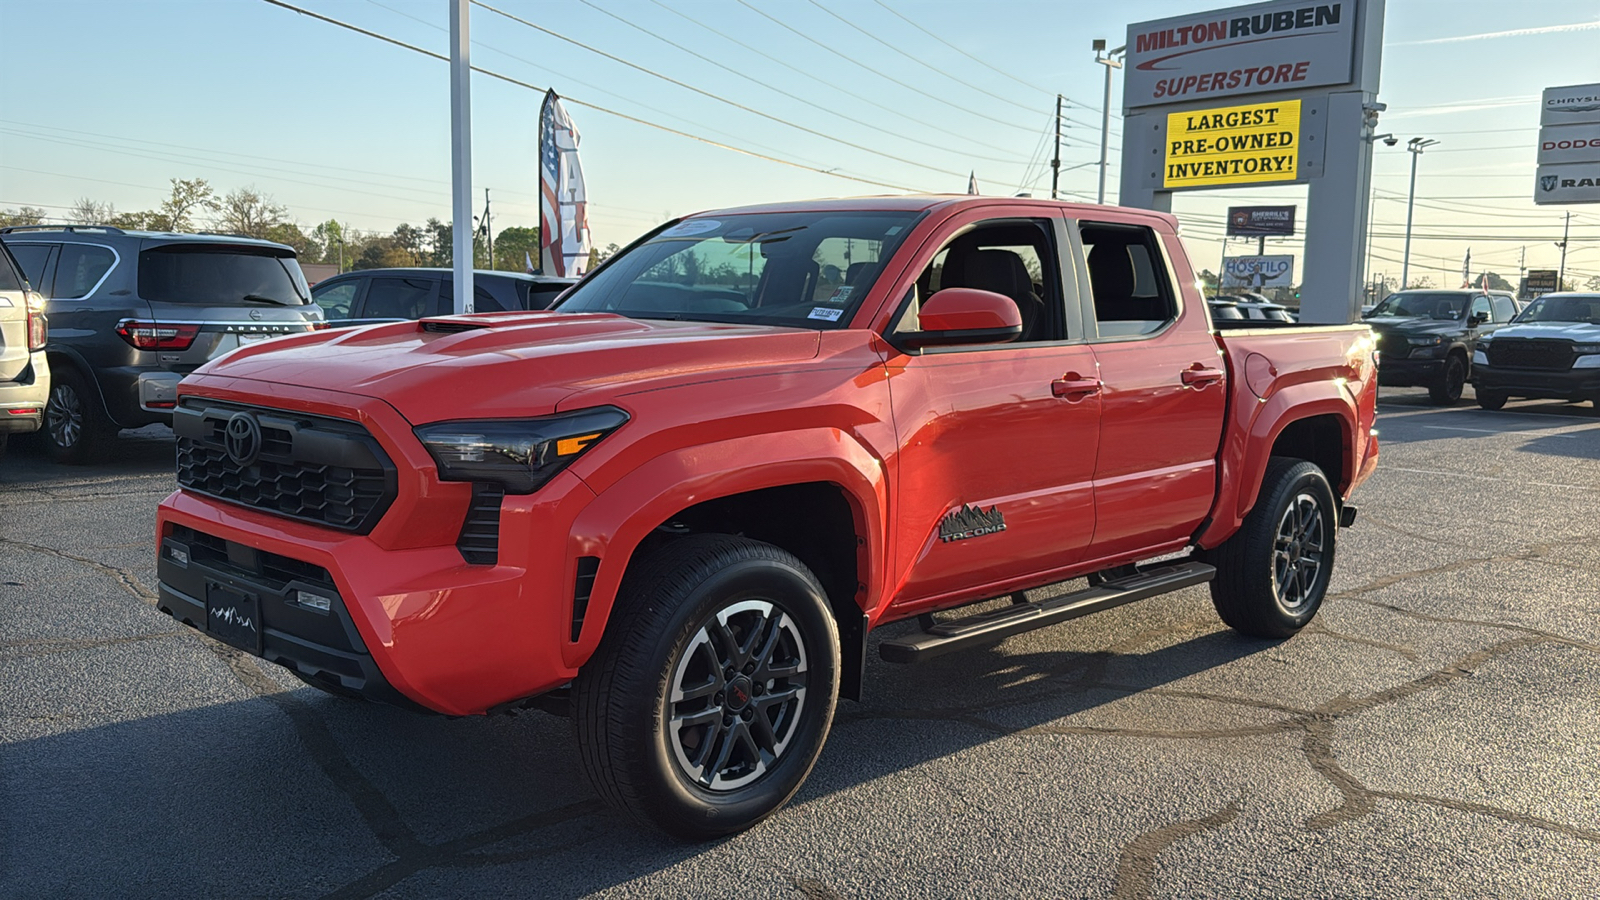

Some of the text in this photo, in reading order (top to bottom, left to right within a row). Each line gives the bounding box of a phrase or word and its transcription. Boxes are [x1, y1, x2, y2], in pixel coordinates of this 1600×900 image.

[1136, 3, 1341, 53] MILTON RUBEN
[1153, 61, 1310, 98] SUPERSTORE
[1186, 108, 1279, 132] LARGEST
[1170, 131, 1293, 156] PRE-OWNED
[1167, 155, 1293, 178] INVENTORY!
[940, 523, 1007, 543] TACOMA
